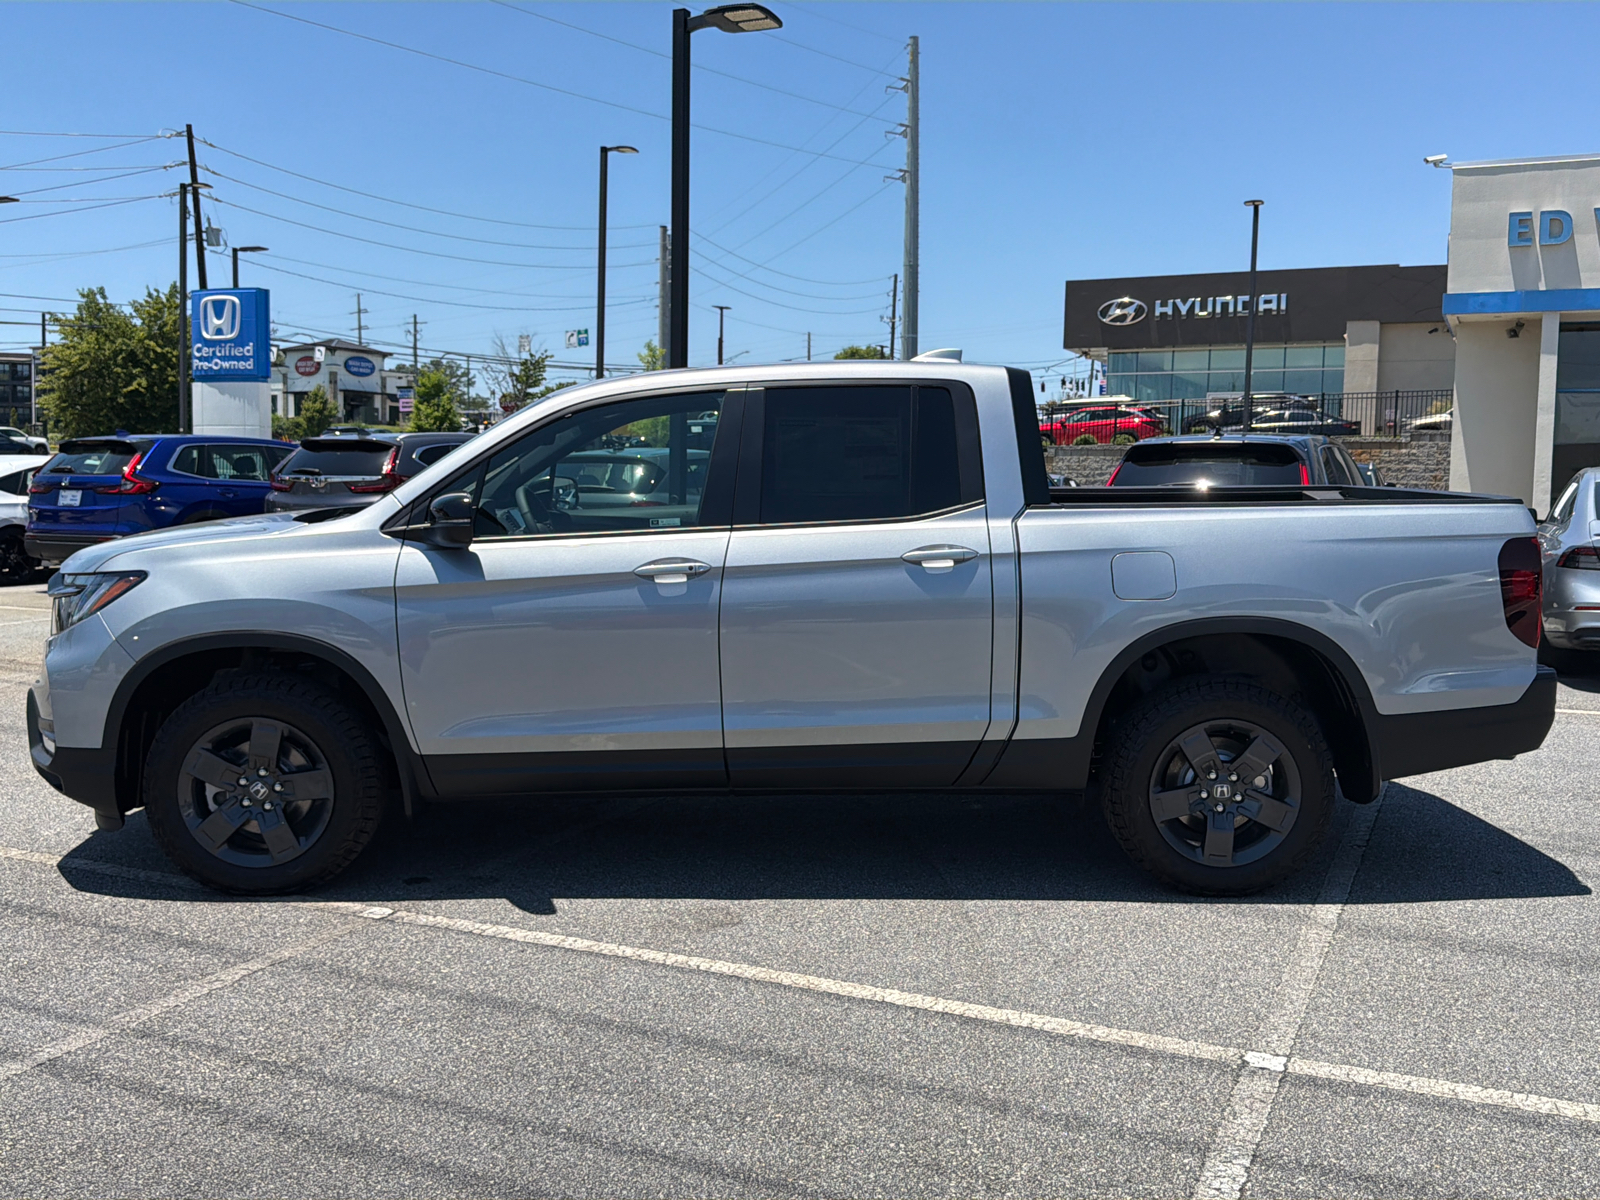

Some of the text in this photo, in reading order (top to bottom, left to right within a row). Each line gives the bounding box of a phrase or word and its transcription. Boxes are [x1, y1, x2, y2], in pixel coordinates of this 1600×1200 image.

[1507, 210, 1573, 247] ED
[1154, 293, 1287, 321] HYUNDAI
[193, 342, 254, 357] Certified
[192, 358, 254, 371] Pre-Owned
